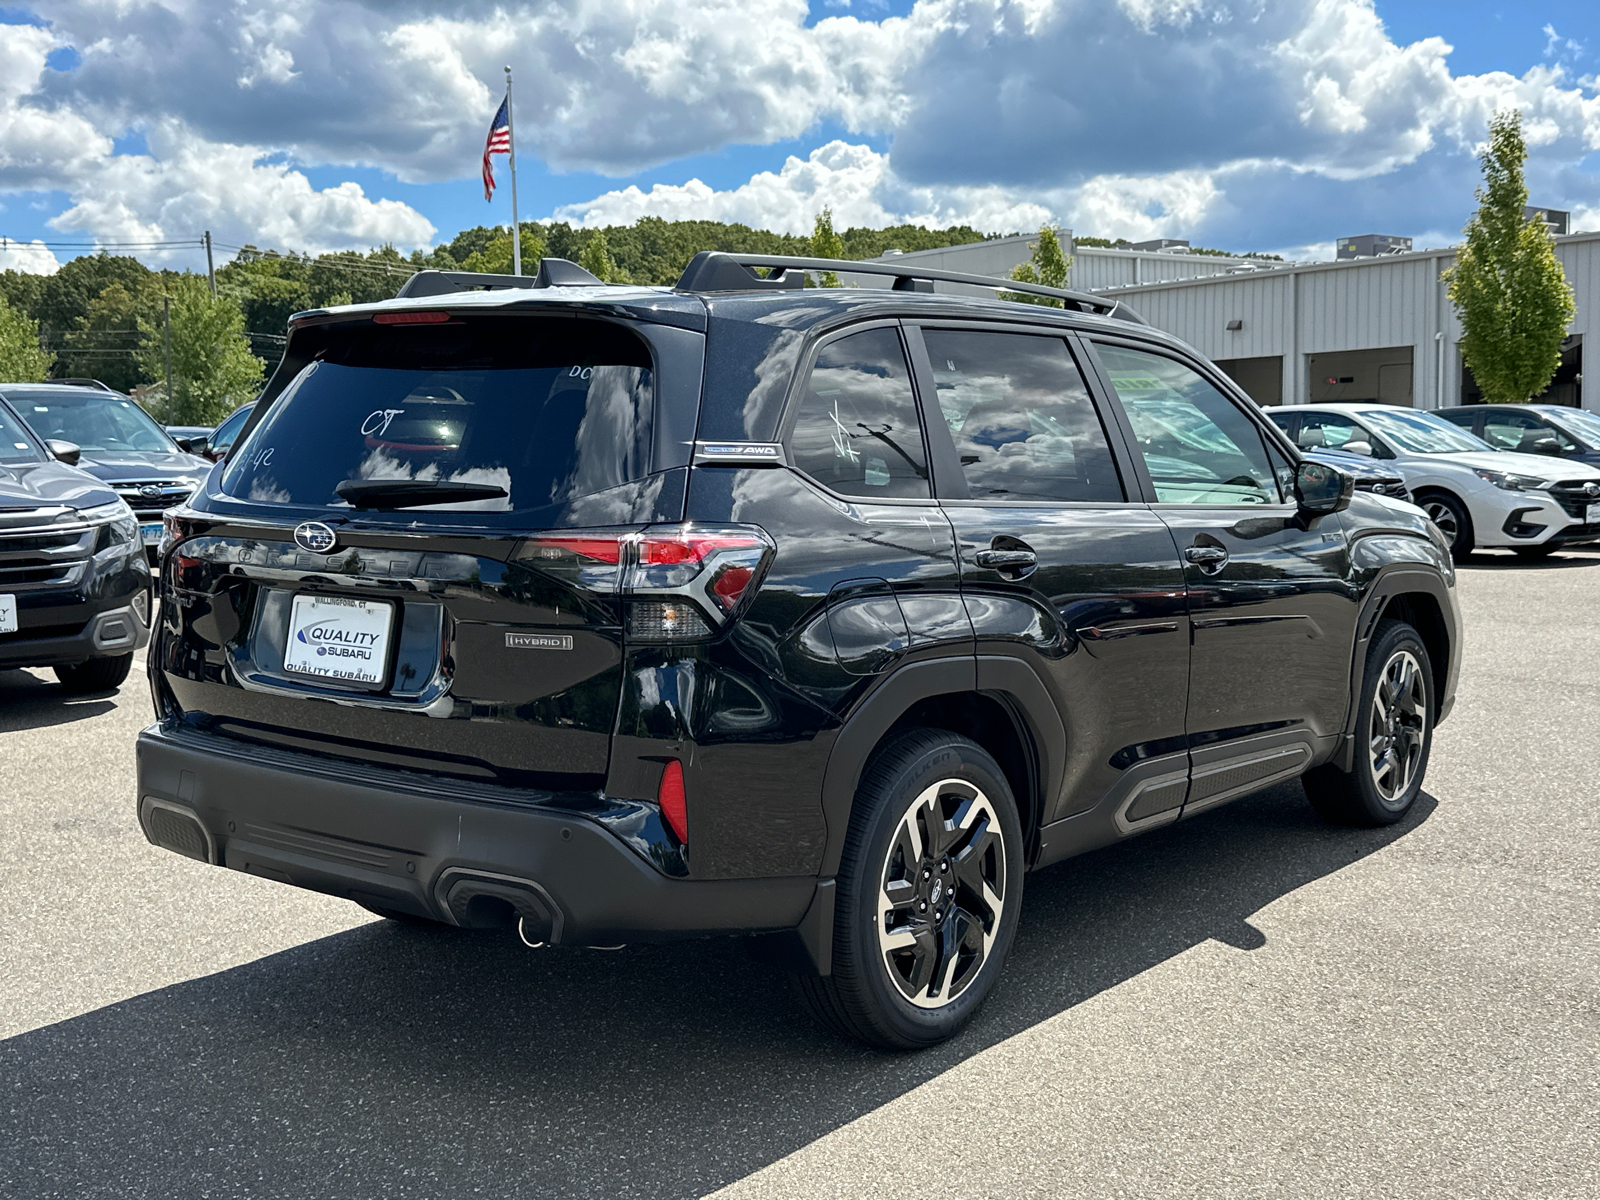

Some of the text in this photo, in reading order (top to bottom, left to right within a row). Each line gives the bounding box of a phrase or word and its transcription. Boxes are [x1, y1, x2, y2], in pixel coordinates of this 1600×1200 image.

[361, 409, 405, 436] CT
[743, 446, 775, 454] AWD
[213, 547, 449, 578] FORESTER
[311, 627, 380, 645] QUALITY
[515, 637, 560, 646] HYBRID
[327, 646, 372, 660] SUBARU
[286, 663, 377, 682] QUALITY SUBARU
